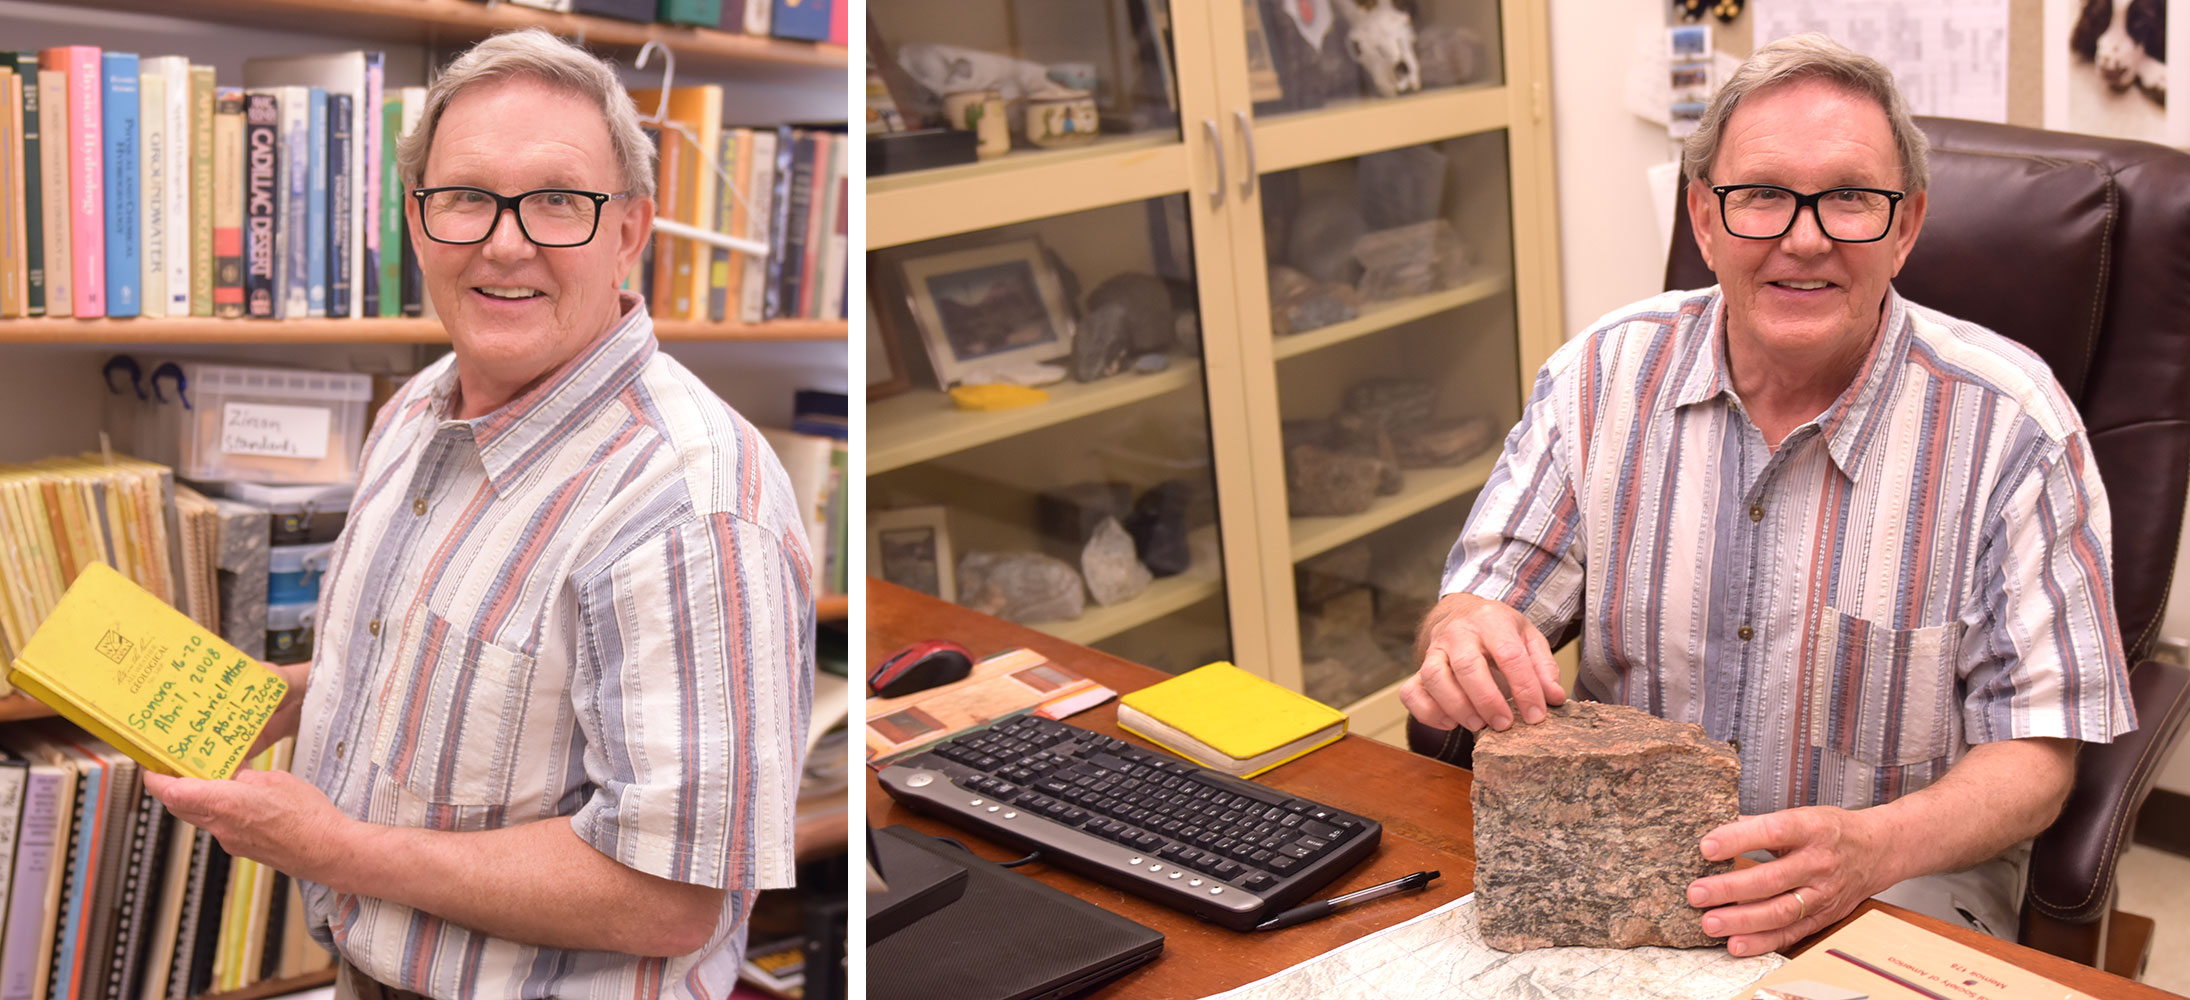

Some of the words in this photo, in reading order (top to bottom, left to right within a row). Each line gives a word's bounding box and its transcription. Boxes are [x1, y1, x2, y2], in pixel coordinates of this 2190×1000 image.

[80, 63, 97, 128] Physical
[197, 91, 211, 158] APPLIED
[80, 133, 97, 216] Hydrology
[150, 132, 162, 273] GROUNDWATER
[250, 128, 275, 215] CADILLAC
[197, 164, 211, 298] HYDROGEOLOGY
[249, 216, 273, 280] DESERT
[128, 681, 176, 730] Sonora
[171, 635, 201, 671] 16-20
[130, 645, 169, 694] GEOLOGICAL
[190, 648, 220, 683] 2008
[167, 734, 197, 760] San
[190, 683, 228, 732] Gabriel
[199, 736, 216, 756] 25
[213, 701, 241, 736] Abril
[222, 725, 248, 746] Aug
[252, 676, 278, 703] 2008
[240, 704, 276, 742] Octubre
[1888, 956, 1929, 976] America
[1940, 979, 1978, 998] Society
[1969, 971, 2008, 989] Memoir
